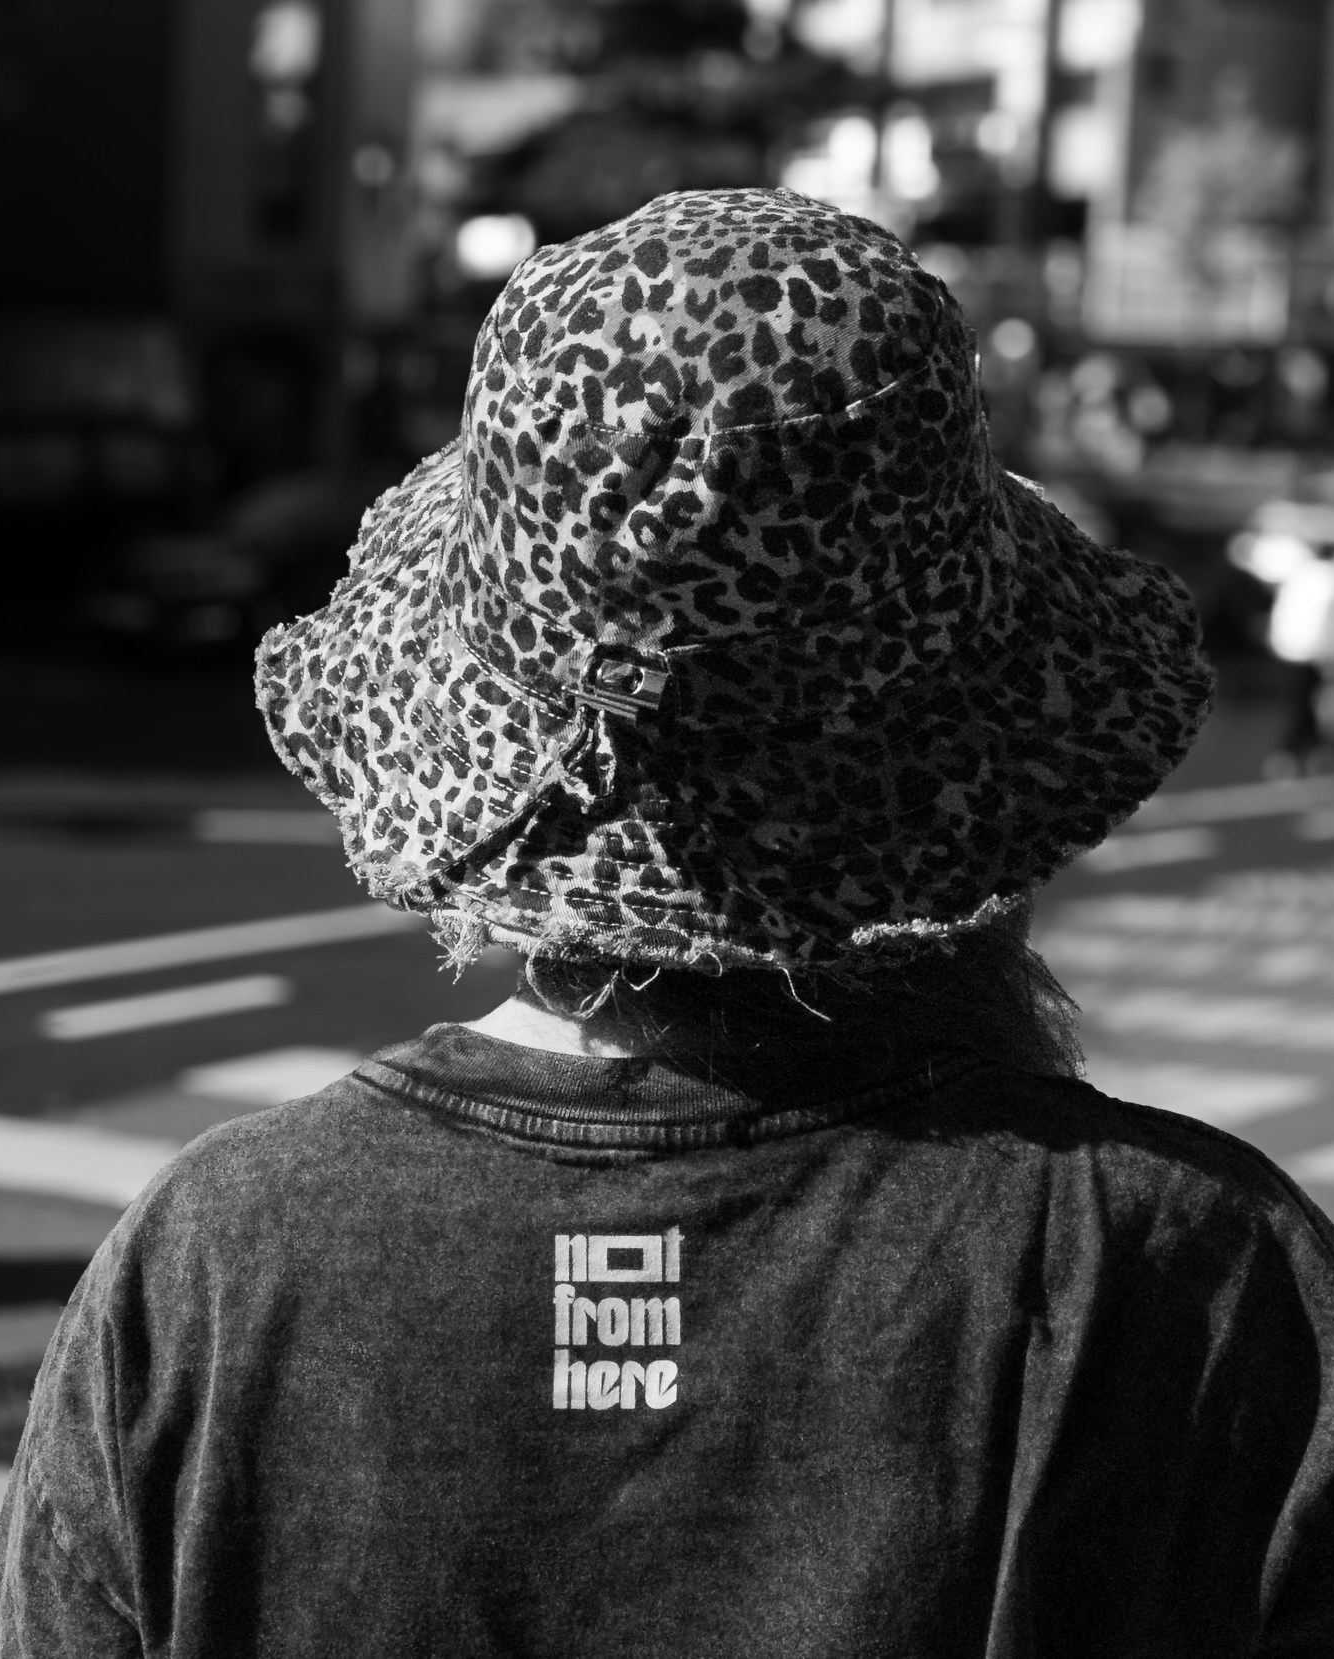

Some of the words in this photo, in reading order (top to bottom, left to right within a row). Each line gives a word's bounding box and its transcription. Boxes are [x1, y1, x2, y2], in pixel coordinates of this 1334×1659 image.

[554, 1225, 685, 1282] not
[553, 1283, 681, 1346] from
[553, 1349, 678, 1410] here
